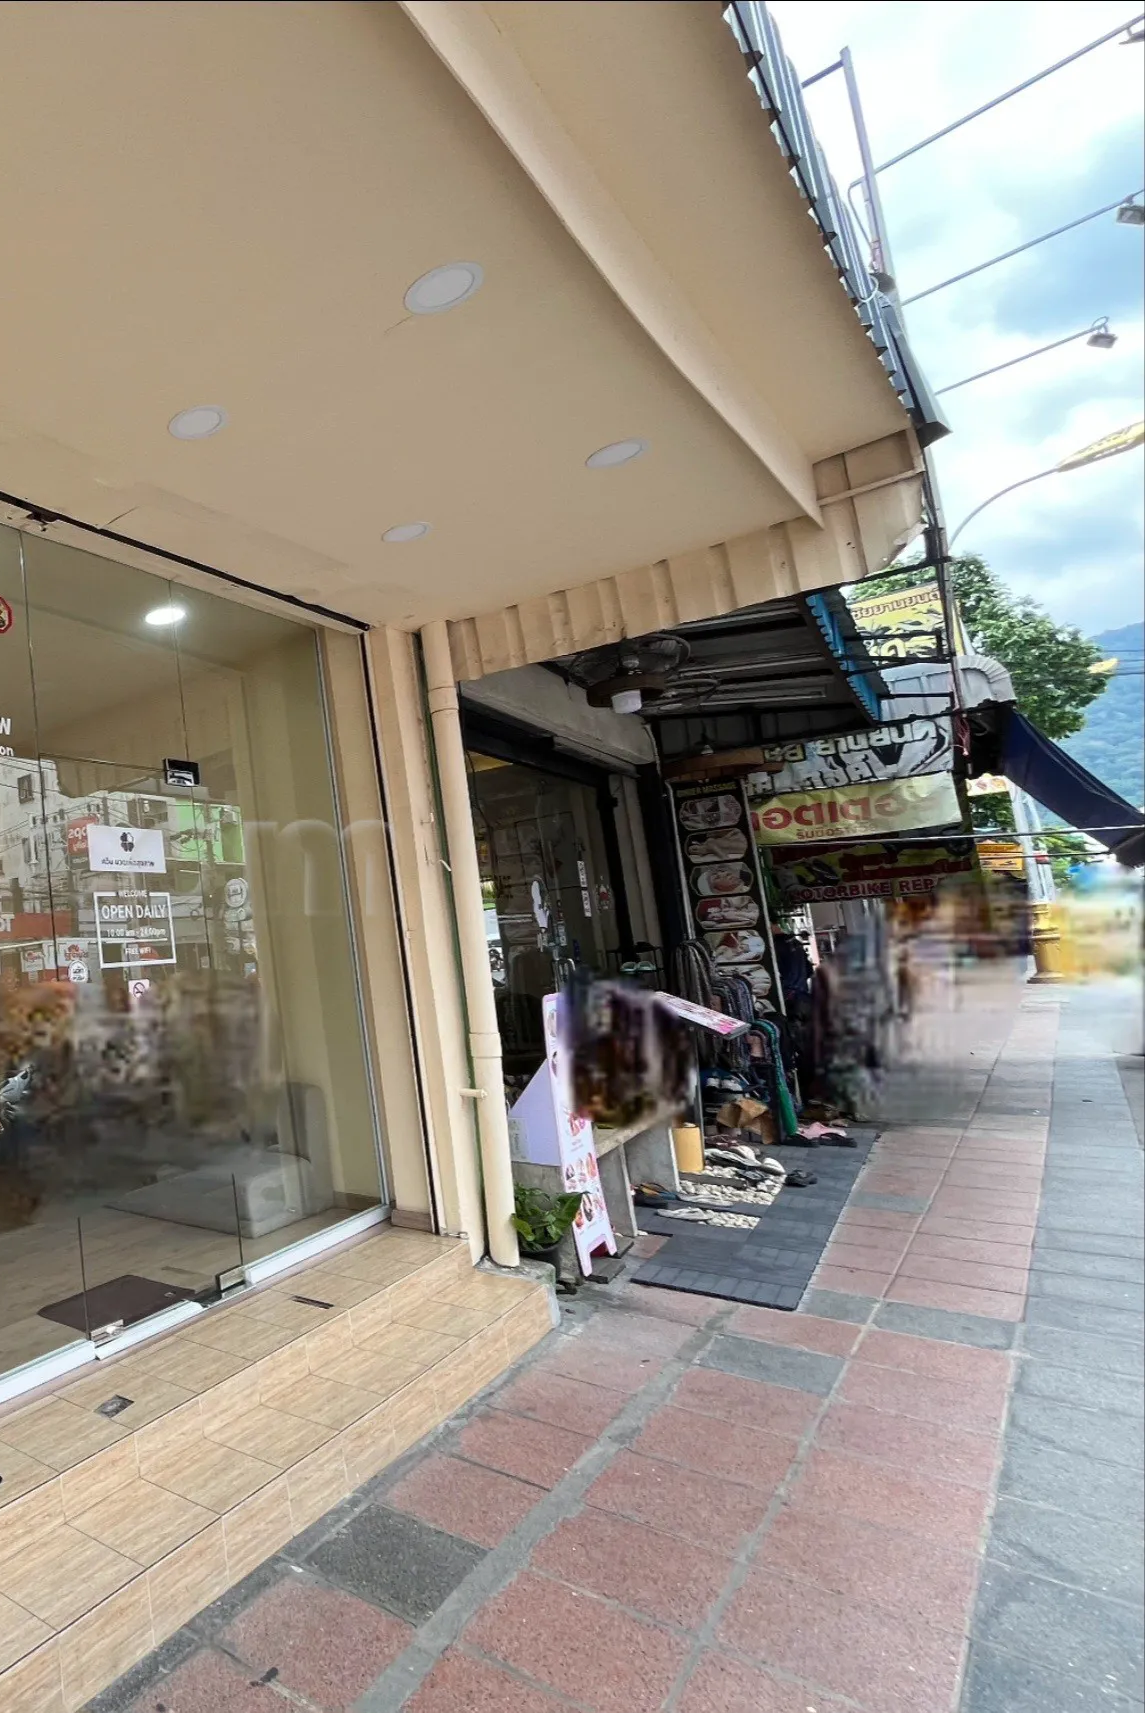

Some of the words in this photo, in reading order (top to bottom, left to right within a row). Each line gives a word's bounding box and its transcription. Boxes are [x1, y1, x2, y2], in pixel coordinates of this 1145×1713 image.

[118, 889, 147, 898] WELCOME
[101, 904, 133, 919] OPEN
[136, 904, 165, 919] DAILY
